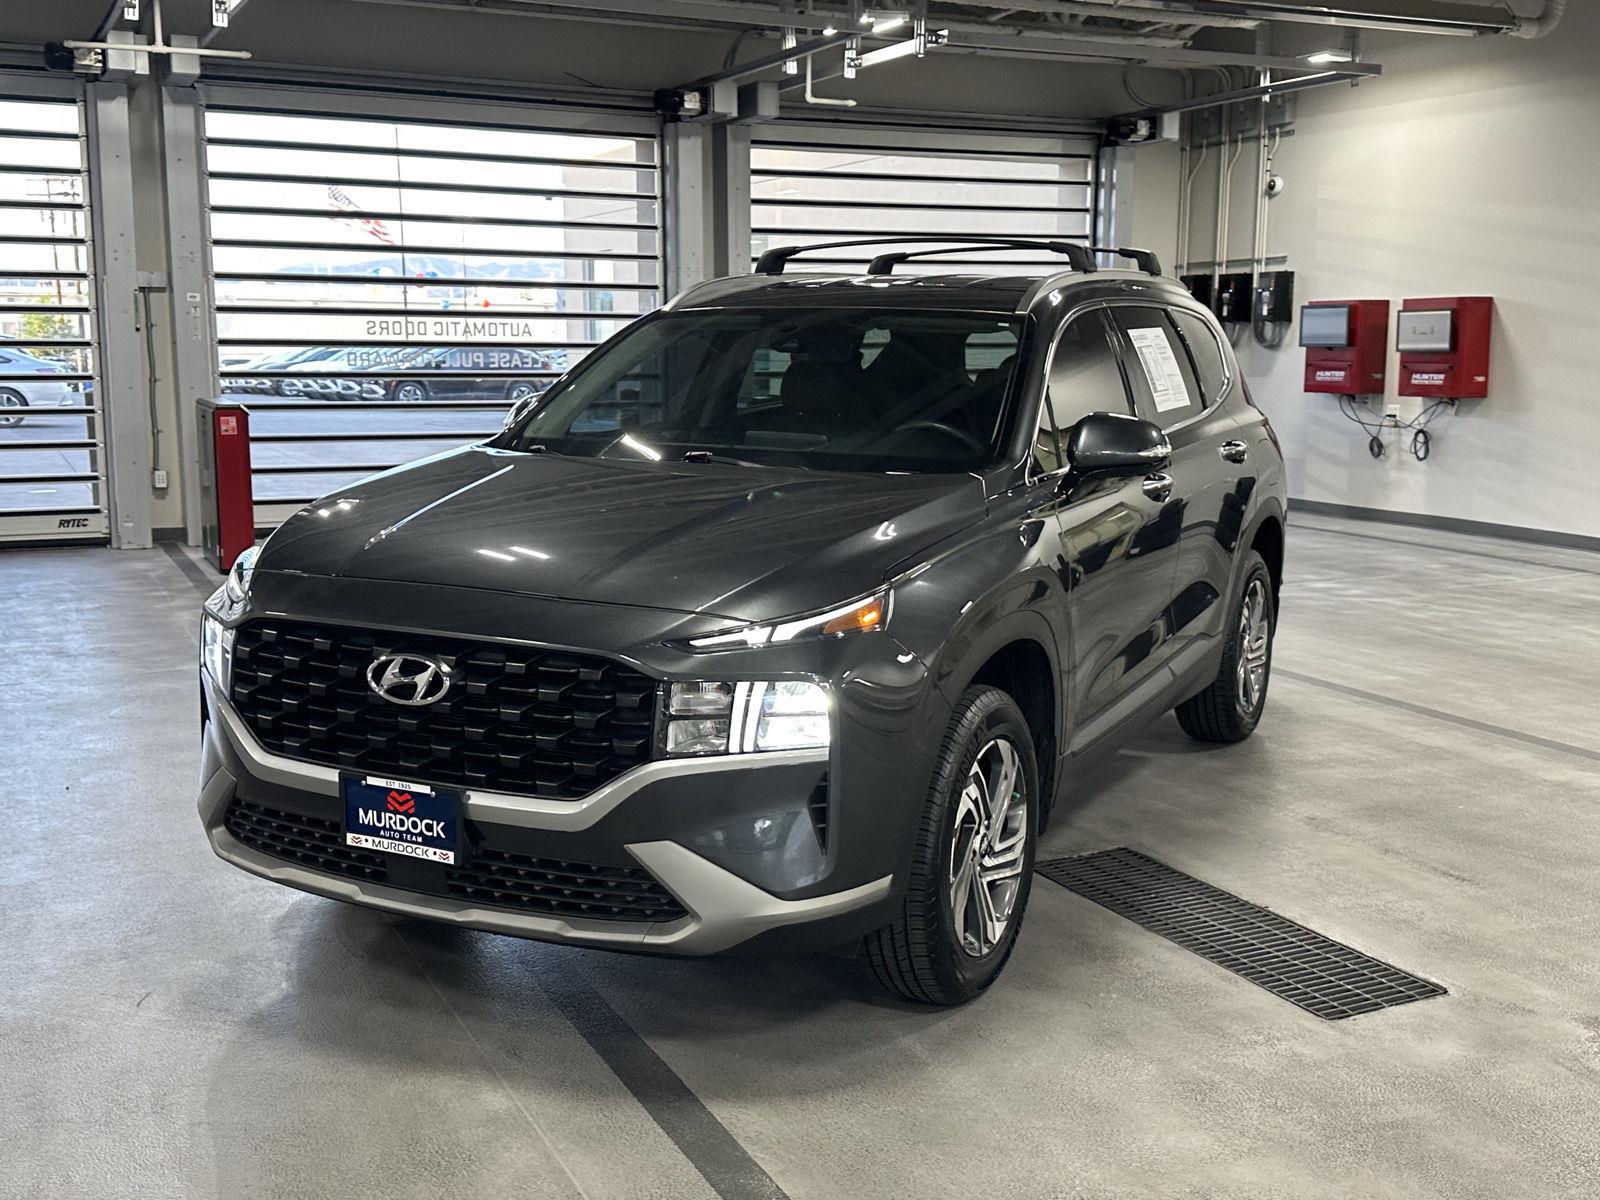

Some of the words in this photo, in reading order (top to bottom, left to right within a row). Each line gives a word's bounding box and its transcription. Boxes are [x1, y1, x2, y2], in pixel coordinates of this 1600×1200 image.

[58, 518, 89, 528] RYTEC
[385, 780, 396, 788] EST
[397, 782, 411, 790] 1925
[358, 807, 446, 839] MURDOCK
[380, 829, 400, 839] AUTO
[402, 833, 423, 843] TEAM
[371, 838, 430, 858] MURDOCK
